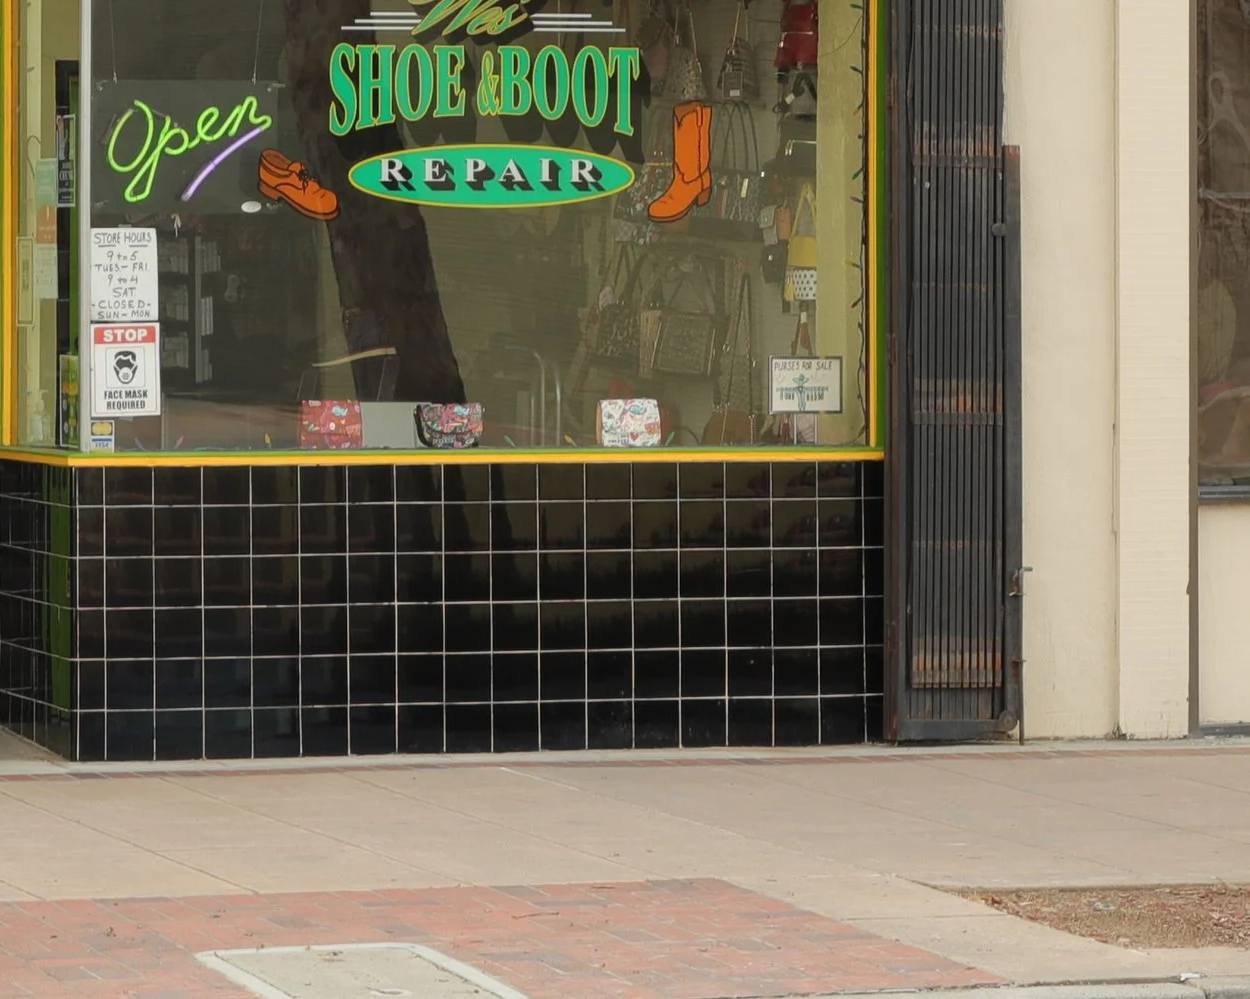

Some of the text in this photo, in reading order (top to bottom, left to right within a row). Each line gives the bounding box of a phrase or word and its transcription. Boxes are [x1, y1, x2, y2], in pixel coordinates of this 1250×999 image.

[329, 43, 466, 136] SHOE
[108, 96, 272, 202] Open
[380, 158, 602, 186] REPAIR
[94, 232, 151, 244] STORE HOURS
[107, 251, 114, 261] 9
[130, 251, 138, 261] 5
[108, 274, 113, 286] 9
[130, 276, 138, 284] 4
[103, 328, 148, 342] STOP
[104, 389, 148, 400] FACE MASK
[107, 400, 146, 410] REQUIRED
